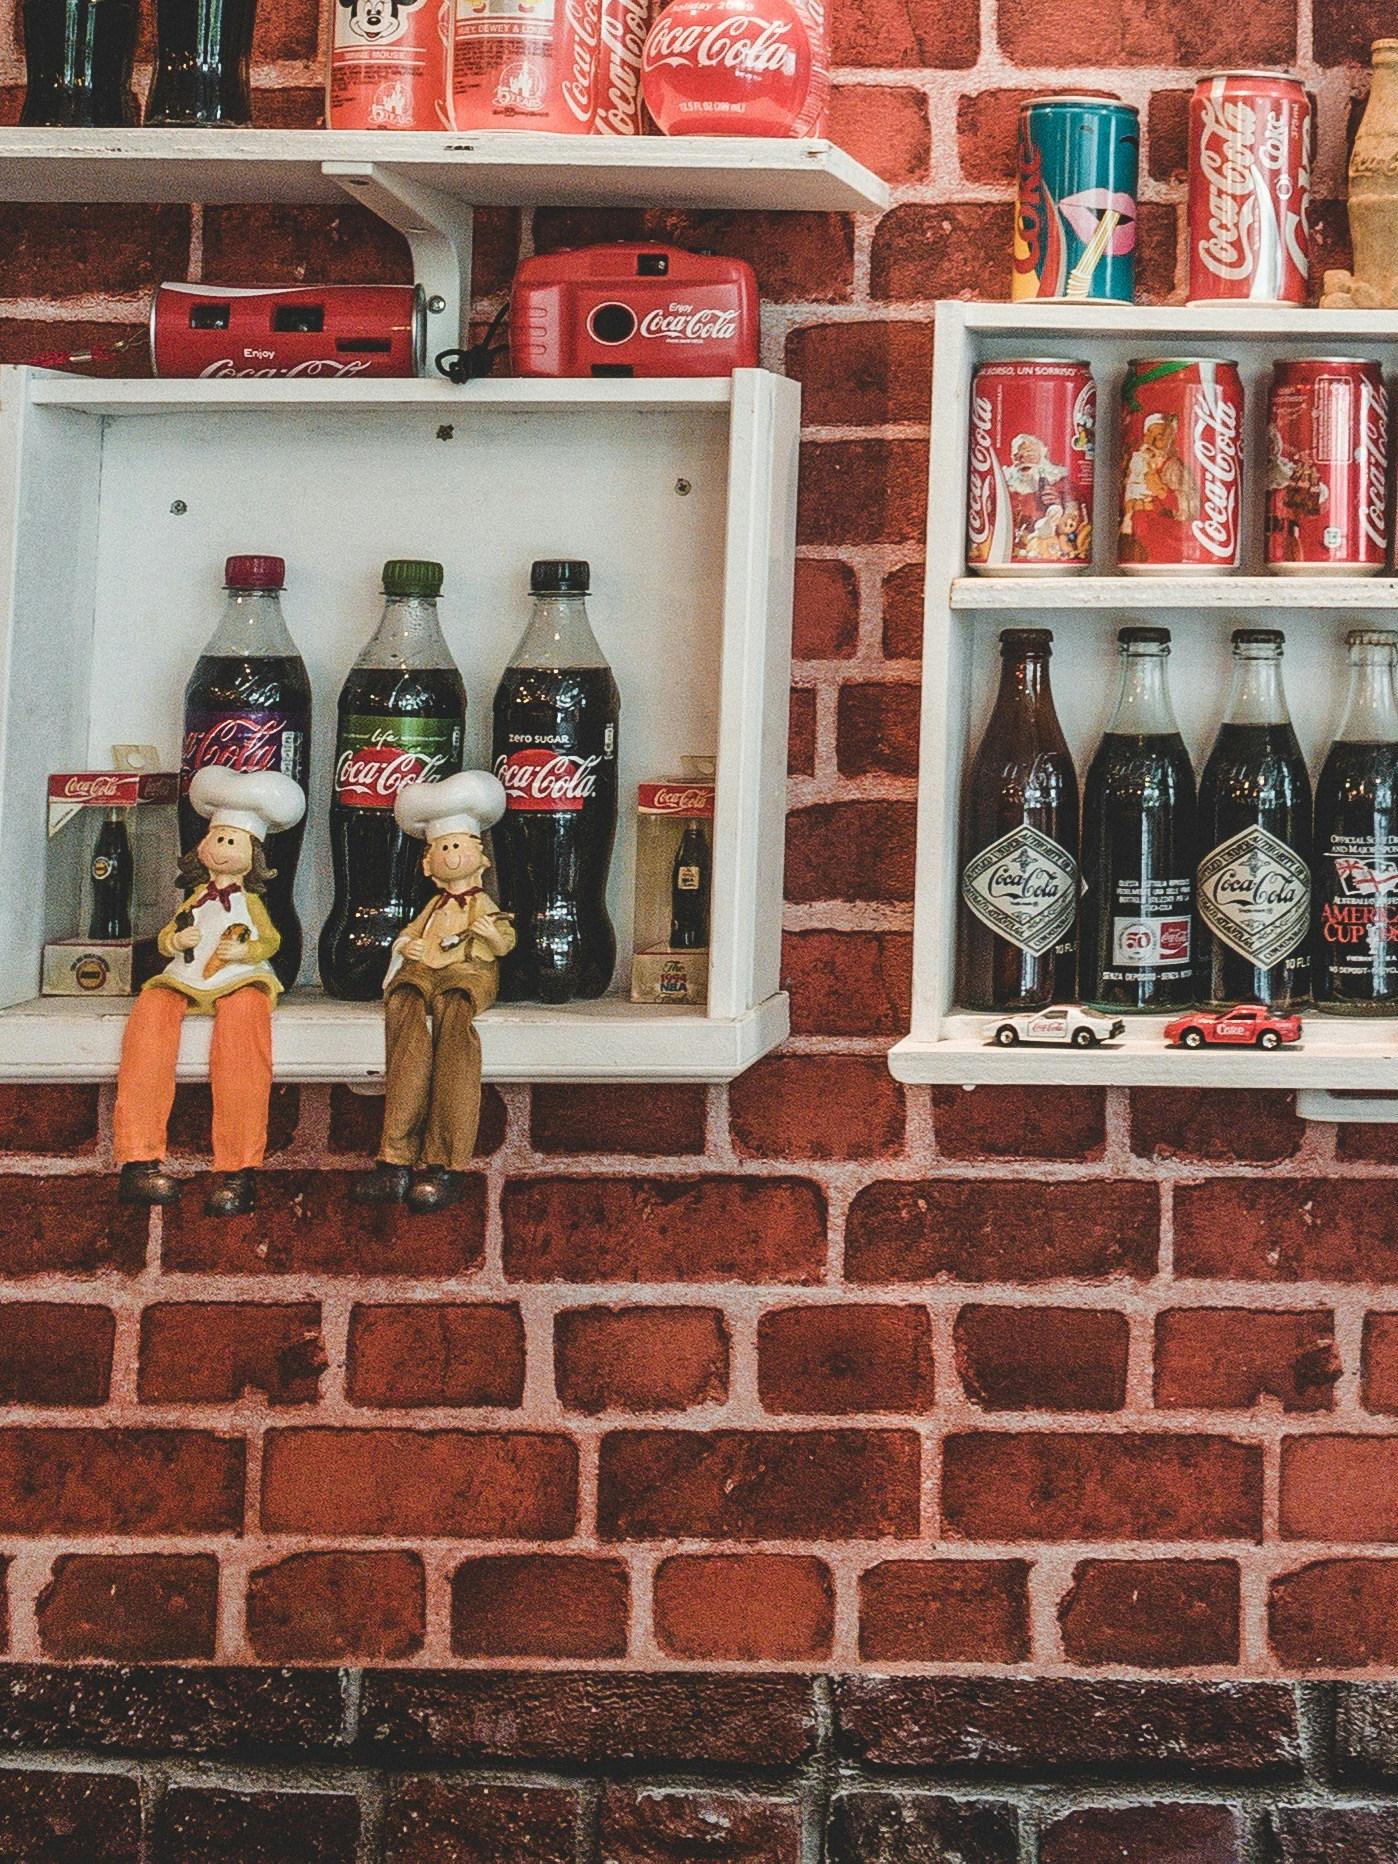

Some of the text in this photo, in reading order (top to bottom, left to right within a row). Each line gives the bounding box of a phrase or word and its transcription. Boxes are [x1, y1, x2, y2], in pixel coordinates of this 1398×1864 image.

[643, 15, 793, 72] Coca-Cola
[1259, 110, 1289, 170] Coke
[1199, 99, 1256, 280] Coca-Cola
[669, 302, 693, 313] Enjoy
[640, 309, 741, 338] Coca-Cola
[243, 348, 275, 360] Enjoy
[1016, 367, 1033, 375] UN
[1192, 393, 1236, 557] Coca-Cola
[370, 728, 400, 751] life
[508, 734, 570, 744] zero SUGAR
[65, 776, 118, 797] Coca-Cola
[653, 788, 707, 809] Coca-Cola
[1330, 834, 1364, 845] OFFICIAL
[1332, 845, 1348, 853] AND
[1349, 845, 1374, 854] MAJOR
[988, 864, 1059, 900] Coca-Cola
[1213, 868, 1297, 906] Coca-Cola
[1127, 932, 1152, 949] 50
[1323, 921, 1365, 944] CUP
[1216, 1023, 1244, 1036] Coke
